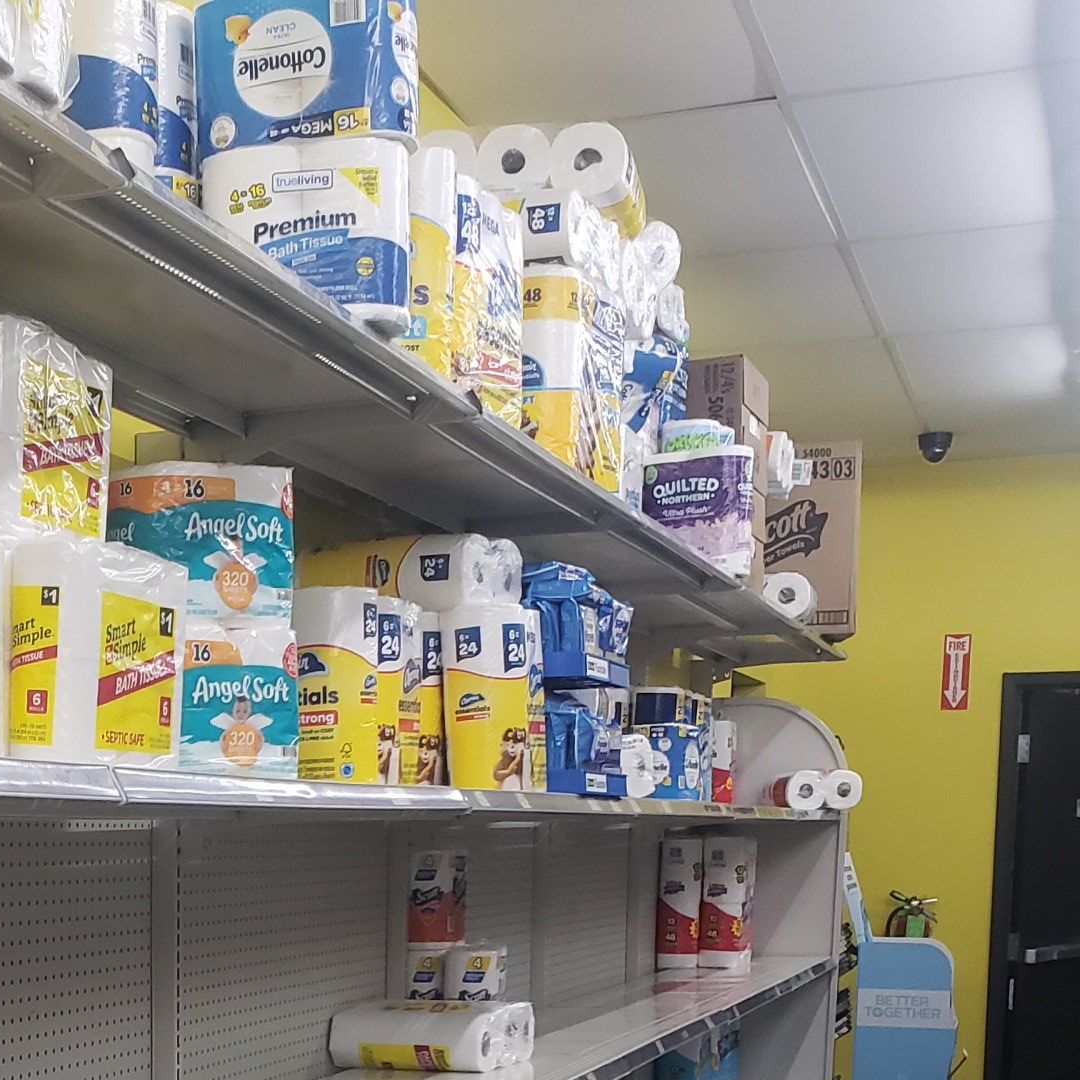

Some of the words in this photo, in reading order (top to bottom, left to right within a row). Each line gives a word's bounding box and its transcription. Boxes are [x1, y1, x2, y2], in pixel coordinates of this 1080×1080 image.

[266, 22, 297, 36] CLEAN
[238, 46, 326, 81] Cottonelle
[291, 118, 332, 136] MEGA
[276, 174, 330, 188] trueliving
[249, 184, 265, 198] 16
[254, 210, 356, 244] Premium
[269, 243, 298, 260] Bath
[299, 235, 343, 251] Tissue
[524, 288, 541, 302] 48
[120, 482, 132, 496] 16
[184, 479, 205, 498] 16
[653, 478, 719, 499] QUILTED
[661, 492, 710, 506] NORTHERN
[184, 512, 244, 542] Angel
[246, 515, 284, 544] Soft
[766, 501, 812, 543] cott
[222, 570, 249, 587] 320
[42, 590, 57, 604] $1
[106, 619, 136, 643] Smart
[161, 611, 173, 636] $1
[193, 643, 211, 662] 16
[381, 635, 399, 655] 24
[459, 641, 478, 656] 24
[508, 643, 524, 662] 24
[948, 641, 967, 651] FIRE
[20, 651, 44, 663] TISSUE
[115, 671, 138, 695] BATH
[192, 676, 250, 704] Angel
[252, 676, 289, 704] Soft
[32, 693, 41, 706] 6
[162, 701, 168, 716] 6
[105, 731, 128, 745] SEPTIC
[129, 732, 145, 747] SAFE
[229, 731, 255, 746] 320
[423, 957, 431, 969] 4
[474, 957, 482, 969] 4
[875, 995, 929, 1007] BETTER
[865, 1006, 941, 1019] TOGETHER
